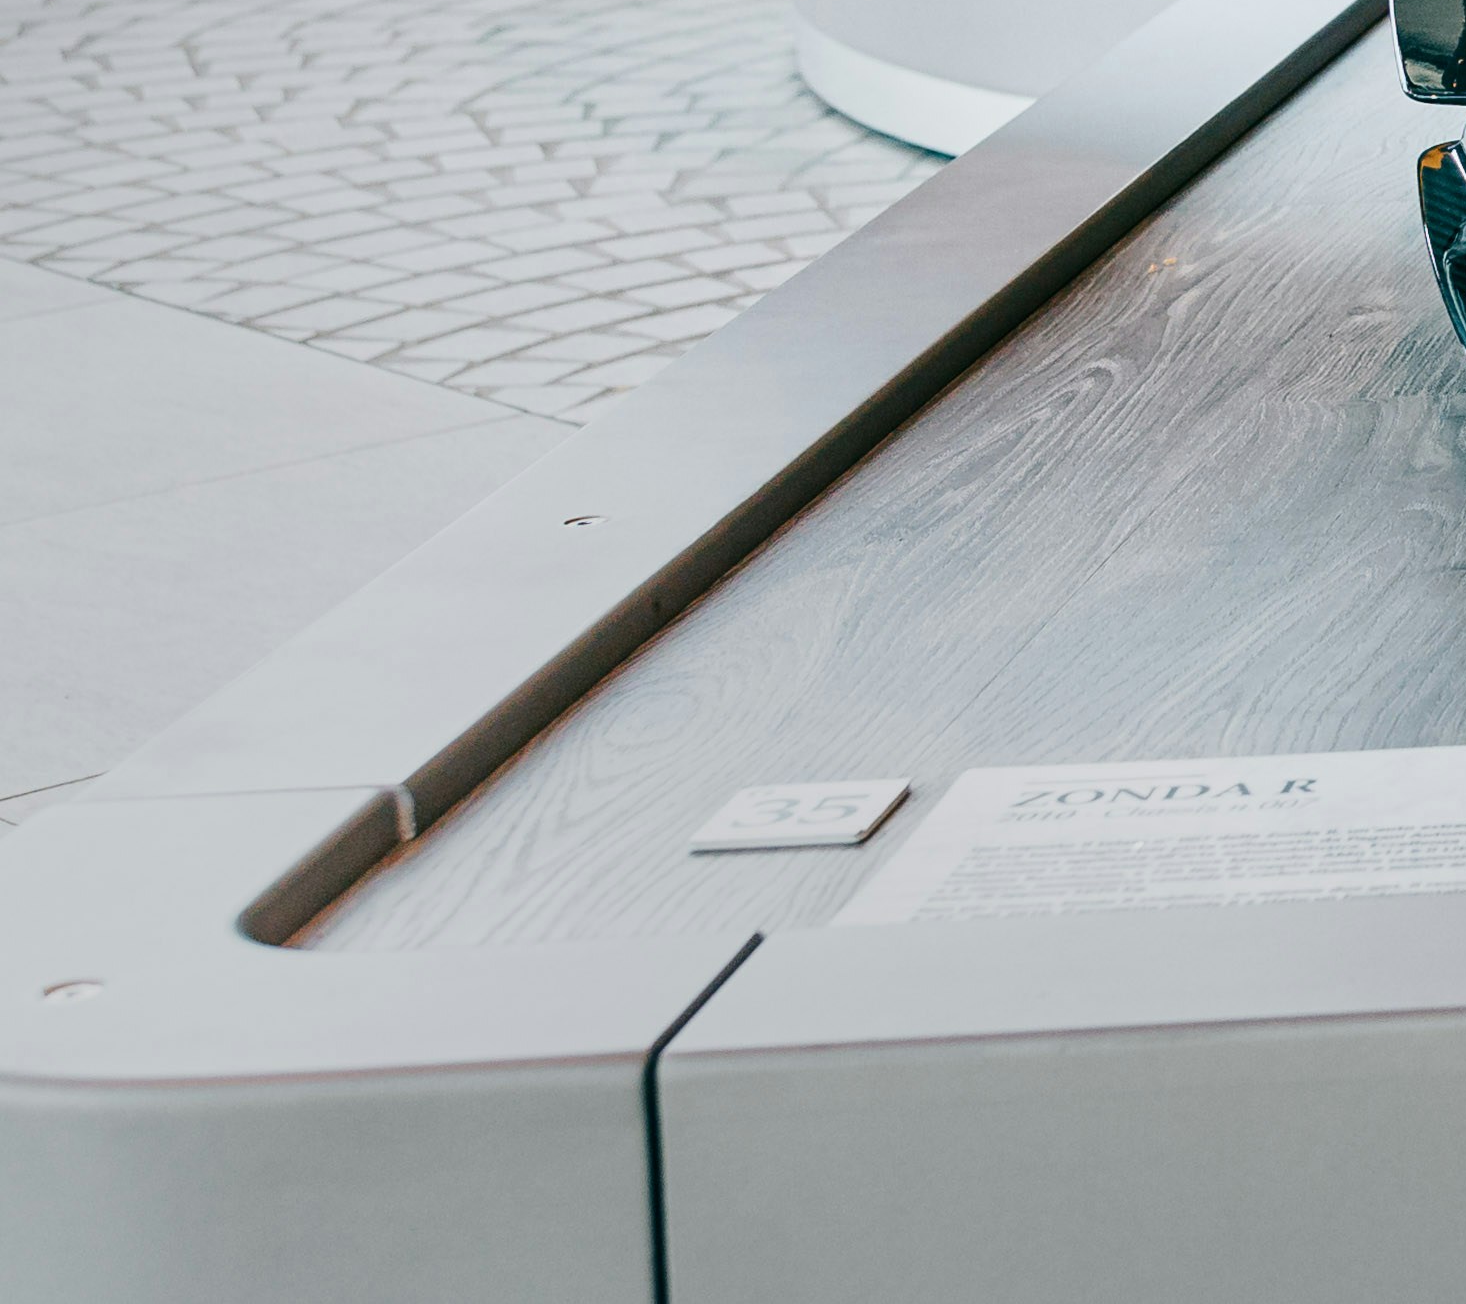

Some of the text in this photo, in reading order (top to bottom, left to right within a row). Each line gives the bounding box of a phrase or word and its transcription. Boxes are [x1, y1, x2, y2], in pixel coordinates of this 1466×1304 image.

[1009, 778, 1318, 807] ZONDA R
[731, 794, 871, 828] 35
